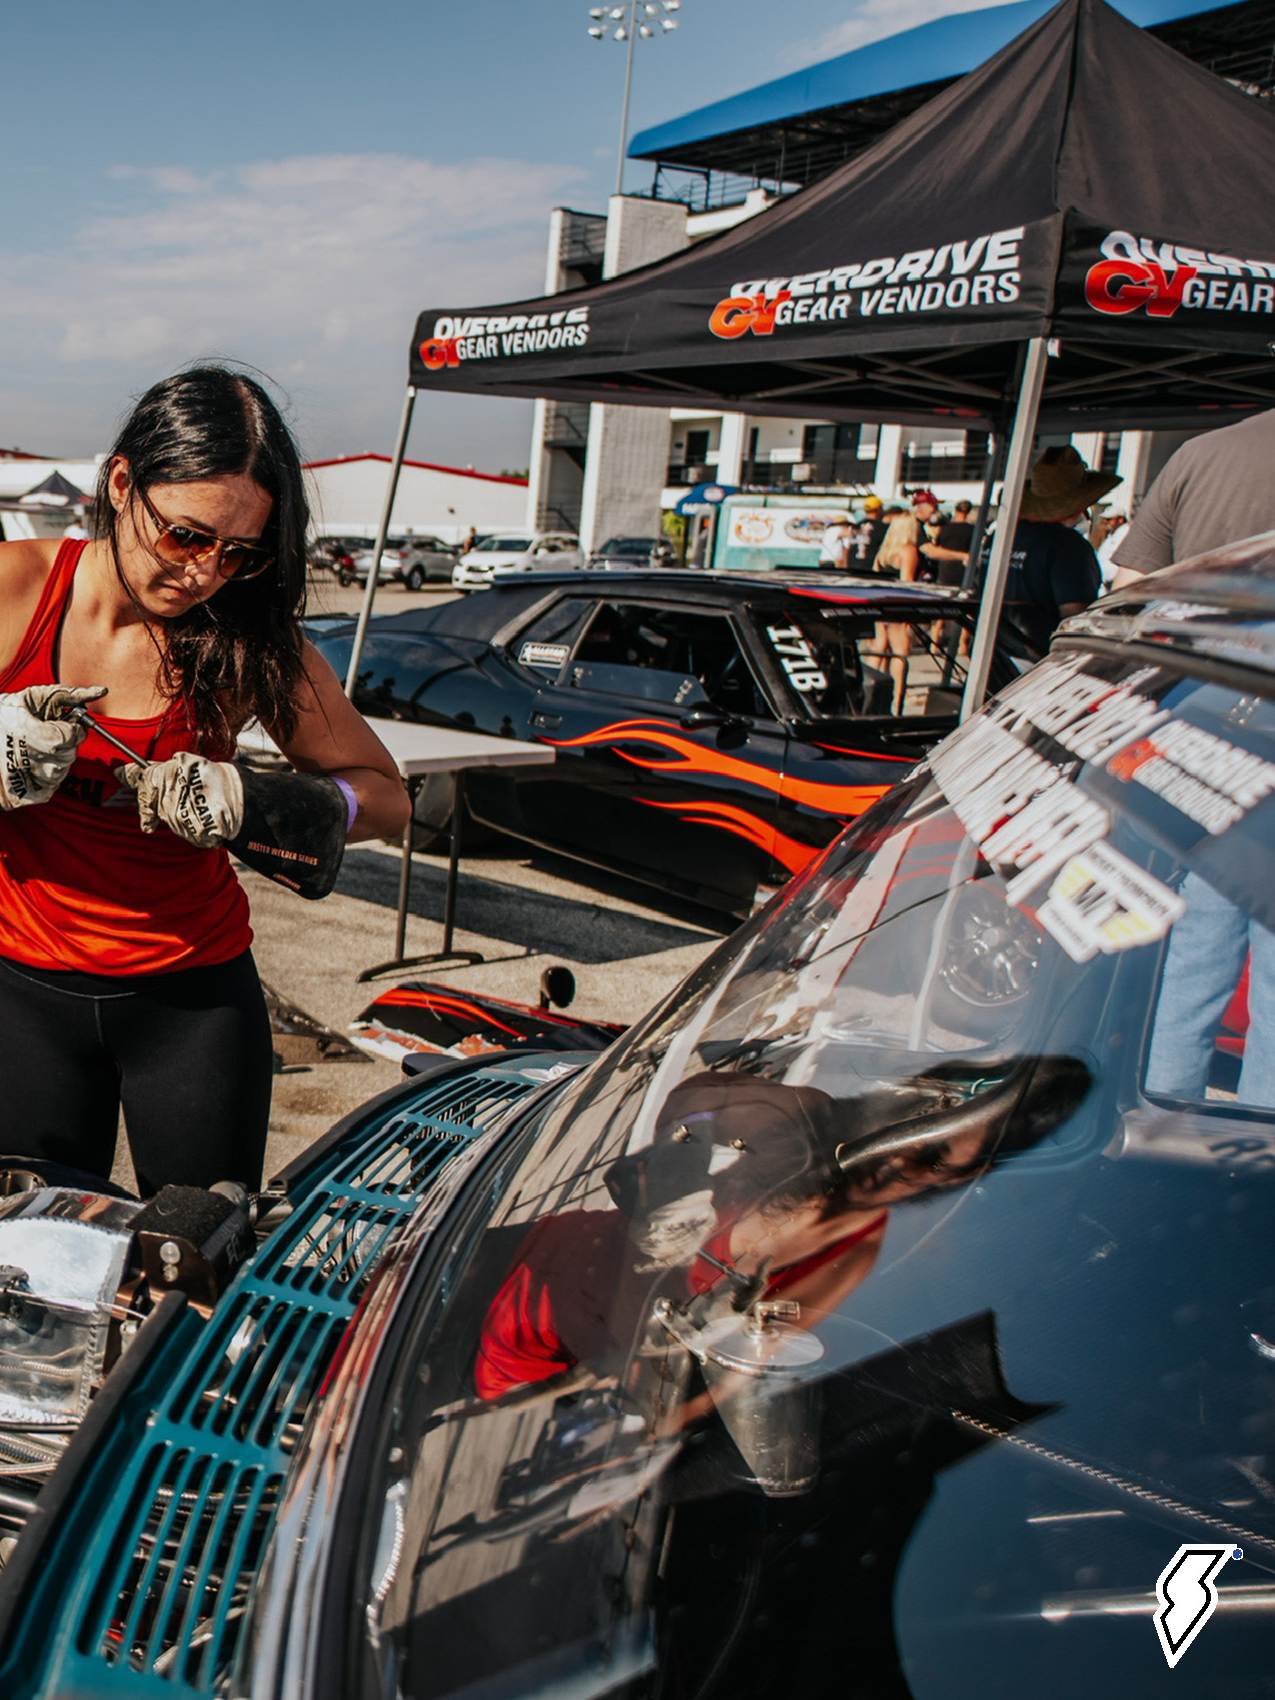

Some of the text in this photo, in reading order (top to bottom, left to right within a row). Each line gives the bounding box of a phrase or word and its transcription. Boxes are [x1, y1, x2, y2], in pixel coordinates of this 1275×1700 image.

[730, 226, 1024, 298] OVERDRIVE
[774, 294, 851, 326] GEAR
[860, 272, 1021, 316] VENDORS
[1181, 277, 1275, 314] GEAR
[456, 334, 499, 361] GEAR
[502, 323, 591, 357] VENDORS
[6, 734, 27, 799] VULCAN
[189, 762, 216, 827] VULCAN
[247, 841, 319, 866] MASTER WELDER SERIES
